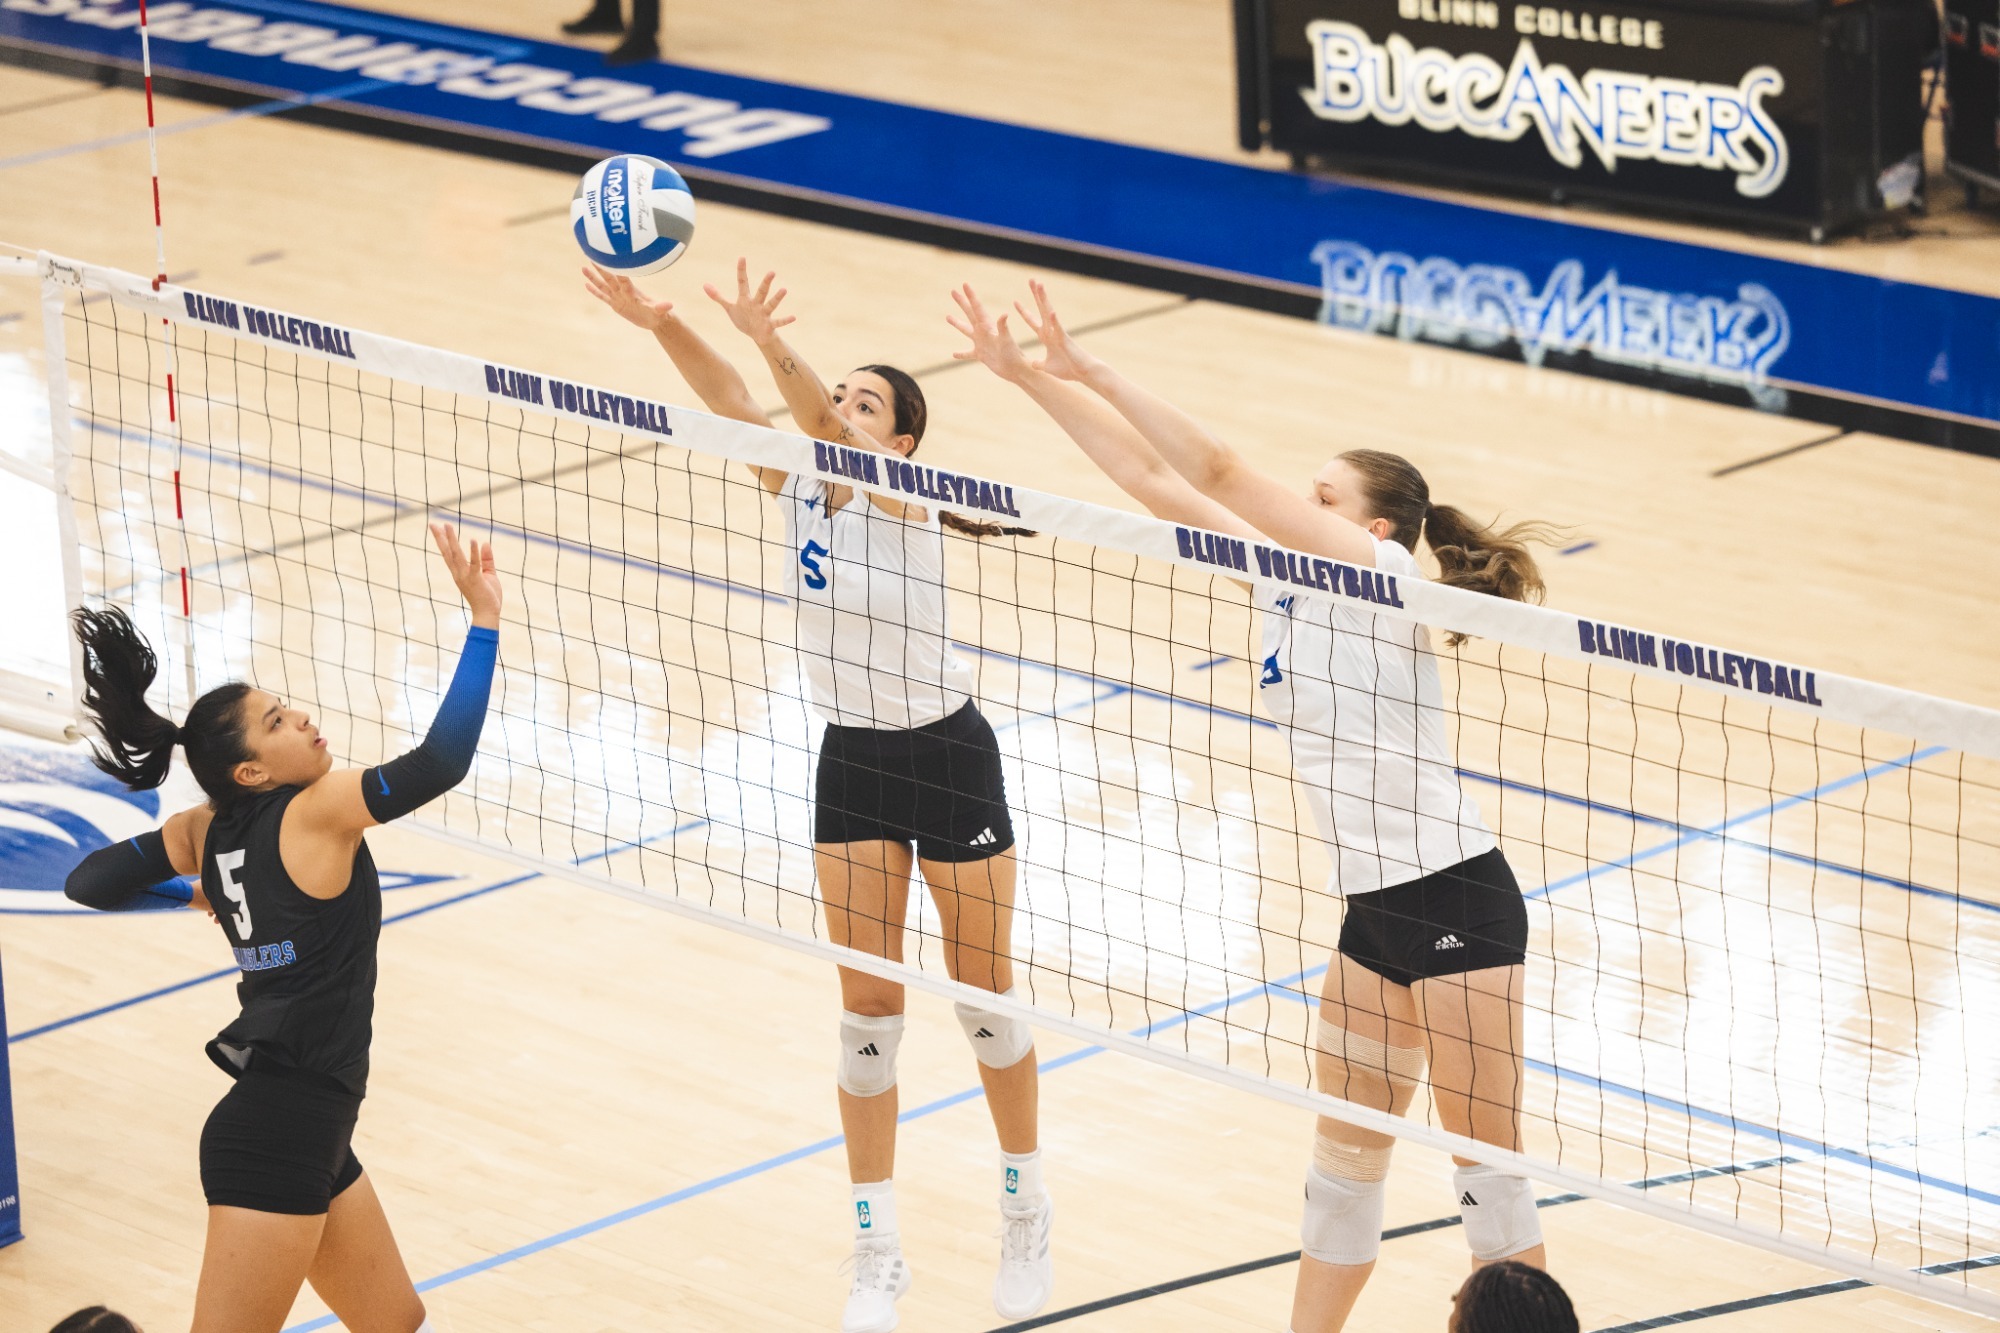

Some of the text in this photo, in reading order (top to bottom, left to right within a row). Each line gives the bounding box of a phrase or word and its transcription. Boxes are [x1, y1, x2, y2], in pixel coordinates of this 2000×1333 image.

[1398, 0, 1664, 50] BLINN COLLEGE
[608, 168, 626, 234] molten
[183, 291, 356, 360] BLINN VOLLEYBALL
[484, 364, 672, 436] BLINN VOLLEYBALL
[814, 440, 1021, 518] BLINN VOLLEYBALL
[800, 539, 829, 590] 5
[1175, 526, 1404, 610] BLINN VOLLEYBALL
[1577, 619, 1822, 707] BLINN VOLLEYBALL
[215, 848, 253, 940] 5
